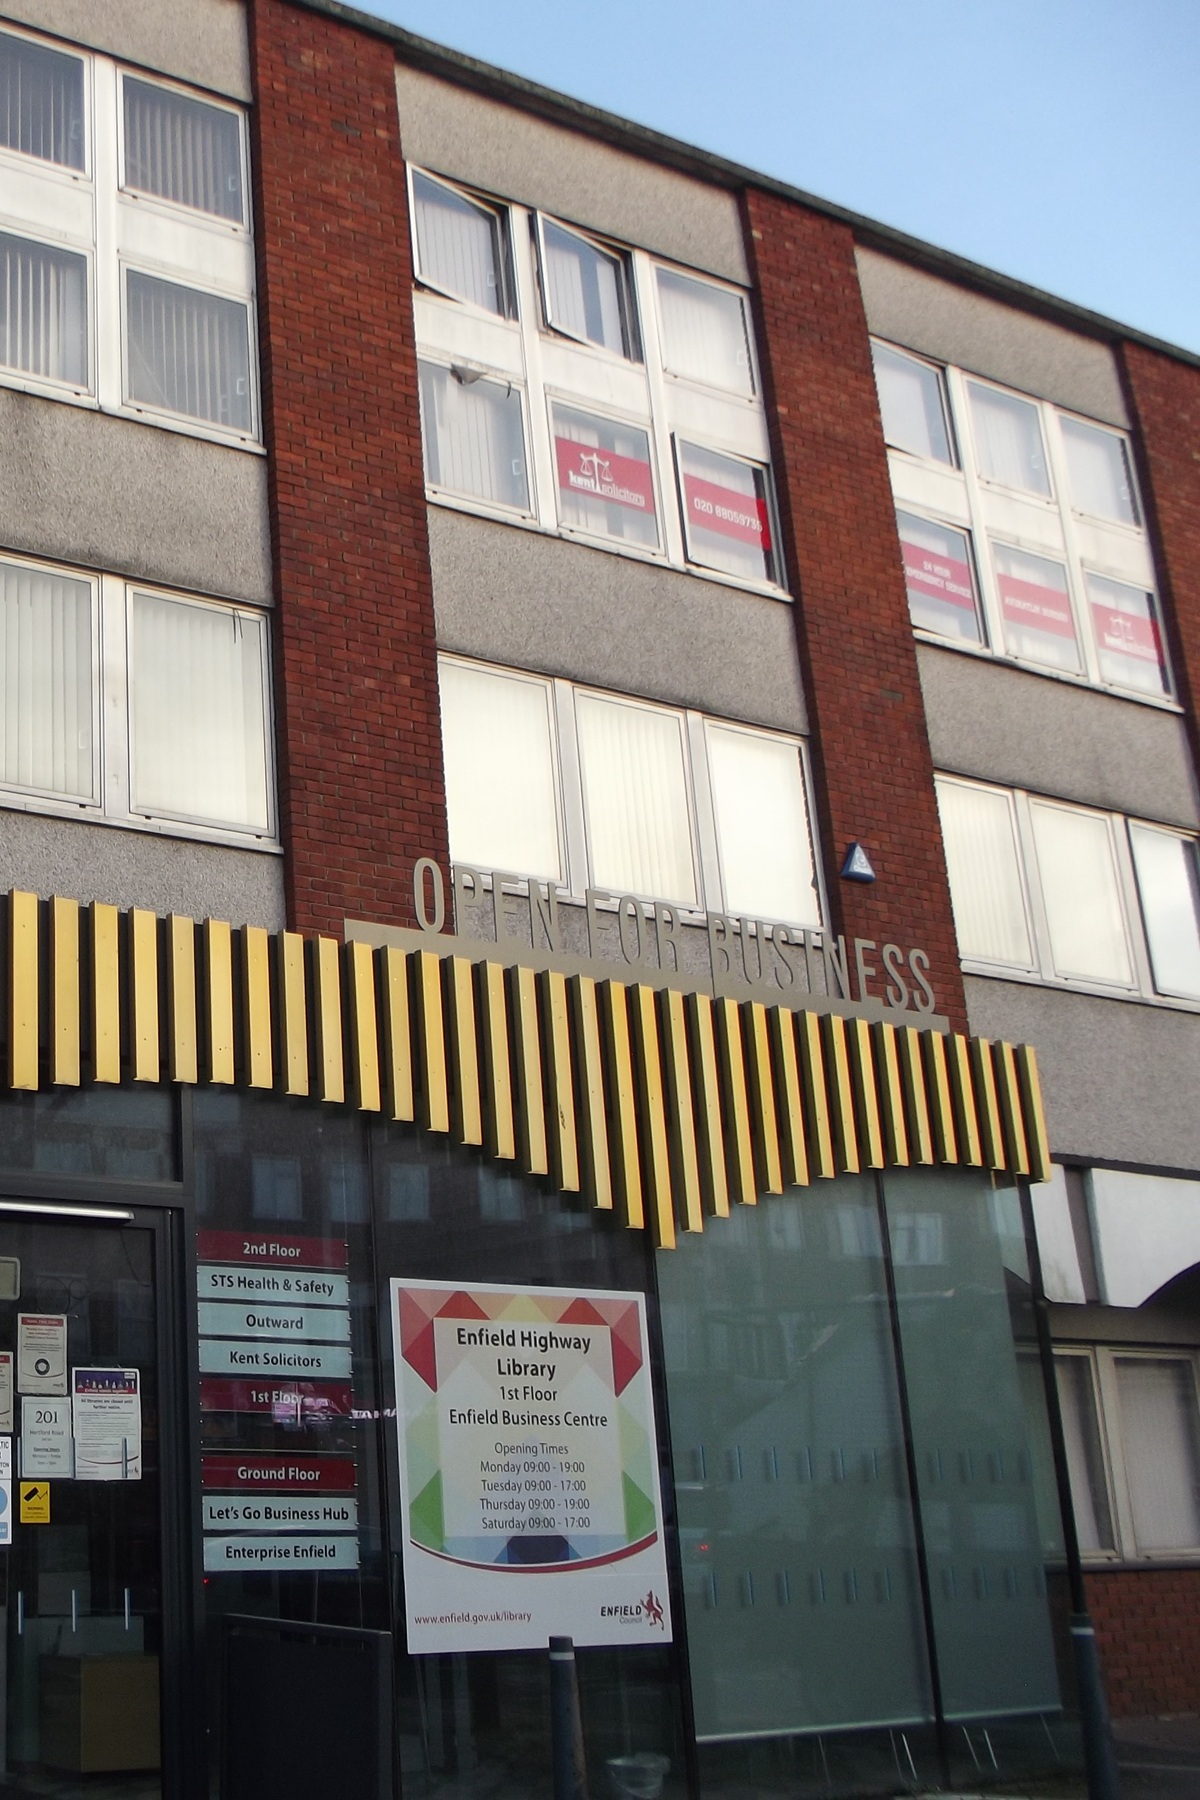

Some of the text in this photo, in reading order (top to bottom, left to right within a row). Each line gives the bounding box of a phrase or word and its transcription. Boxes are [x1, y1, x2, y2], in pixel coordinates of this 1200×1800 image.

[694, 497, 713, 514] 020
[413, 857, 936, 1014] OPEN FOR BUSINESS
[243, 1242, 301, 1257] 2nd Floor
[211, 1274, 334, 1297] STS Health & Safety
[246, 1313, 304, 1330] Outward
[456, 1327, 591, 1354] Enfield Highway
[229, 1351, 322, 1368] Kent Solicitors
[497, 1358, 556, 1382] Library
[250, 1390, 304, 1404] 1st Floor
[499, 1385, 557, 1402] 1st Floor
[35, 1410, 59, 1424] 201
[449, 1409, 608, 1428] Enfield Business Centre
[494, 1442, 569, 1457] Opening Times
[237, 1466, 321, 1481] Ground Floor
[480, 1461, 522, 1476] Monday
[523, 1462, 550, 1473] 09:00
[559, 1462, 585, 1473] 19:00
[481, 1479, 523, 1494] Tuesday
[524, 1480, 551, 1491] 09:00
[560, 1480, 586, 1491] 17:00
[480, 1498, 526, 1513] Thursday
[528, 1499, 555, 1510] 09:00
[564, 1499, 590, 1510] 19:00
[242, 1507, 261, 1520] Go
[264, 1507, 320, 1520] Business
[323, 1507, 349, 1520] Hub
[481, 1517, 527, 1531] Saturday
[528, 1517, 556, 1528] 09:00
[564, 1517, 590, 1528] 17:00
[225, 1545, 336, 1561] Enterprise Enfield
[414, 1611, 532, 1625] www.enfield.gov.uk/library
[600, 1605, 642, 1617] ENFIELD
[618, 1616, 643, 1625] Council
